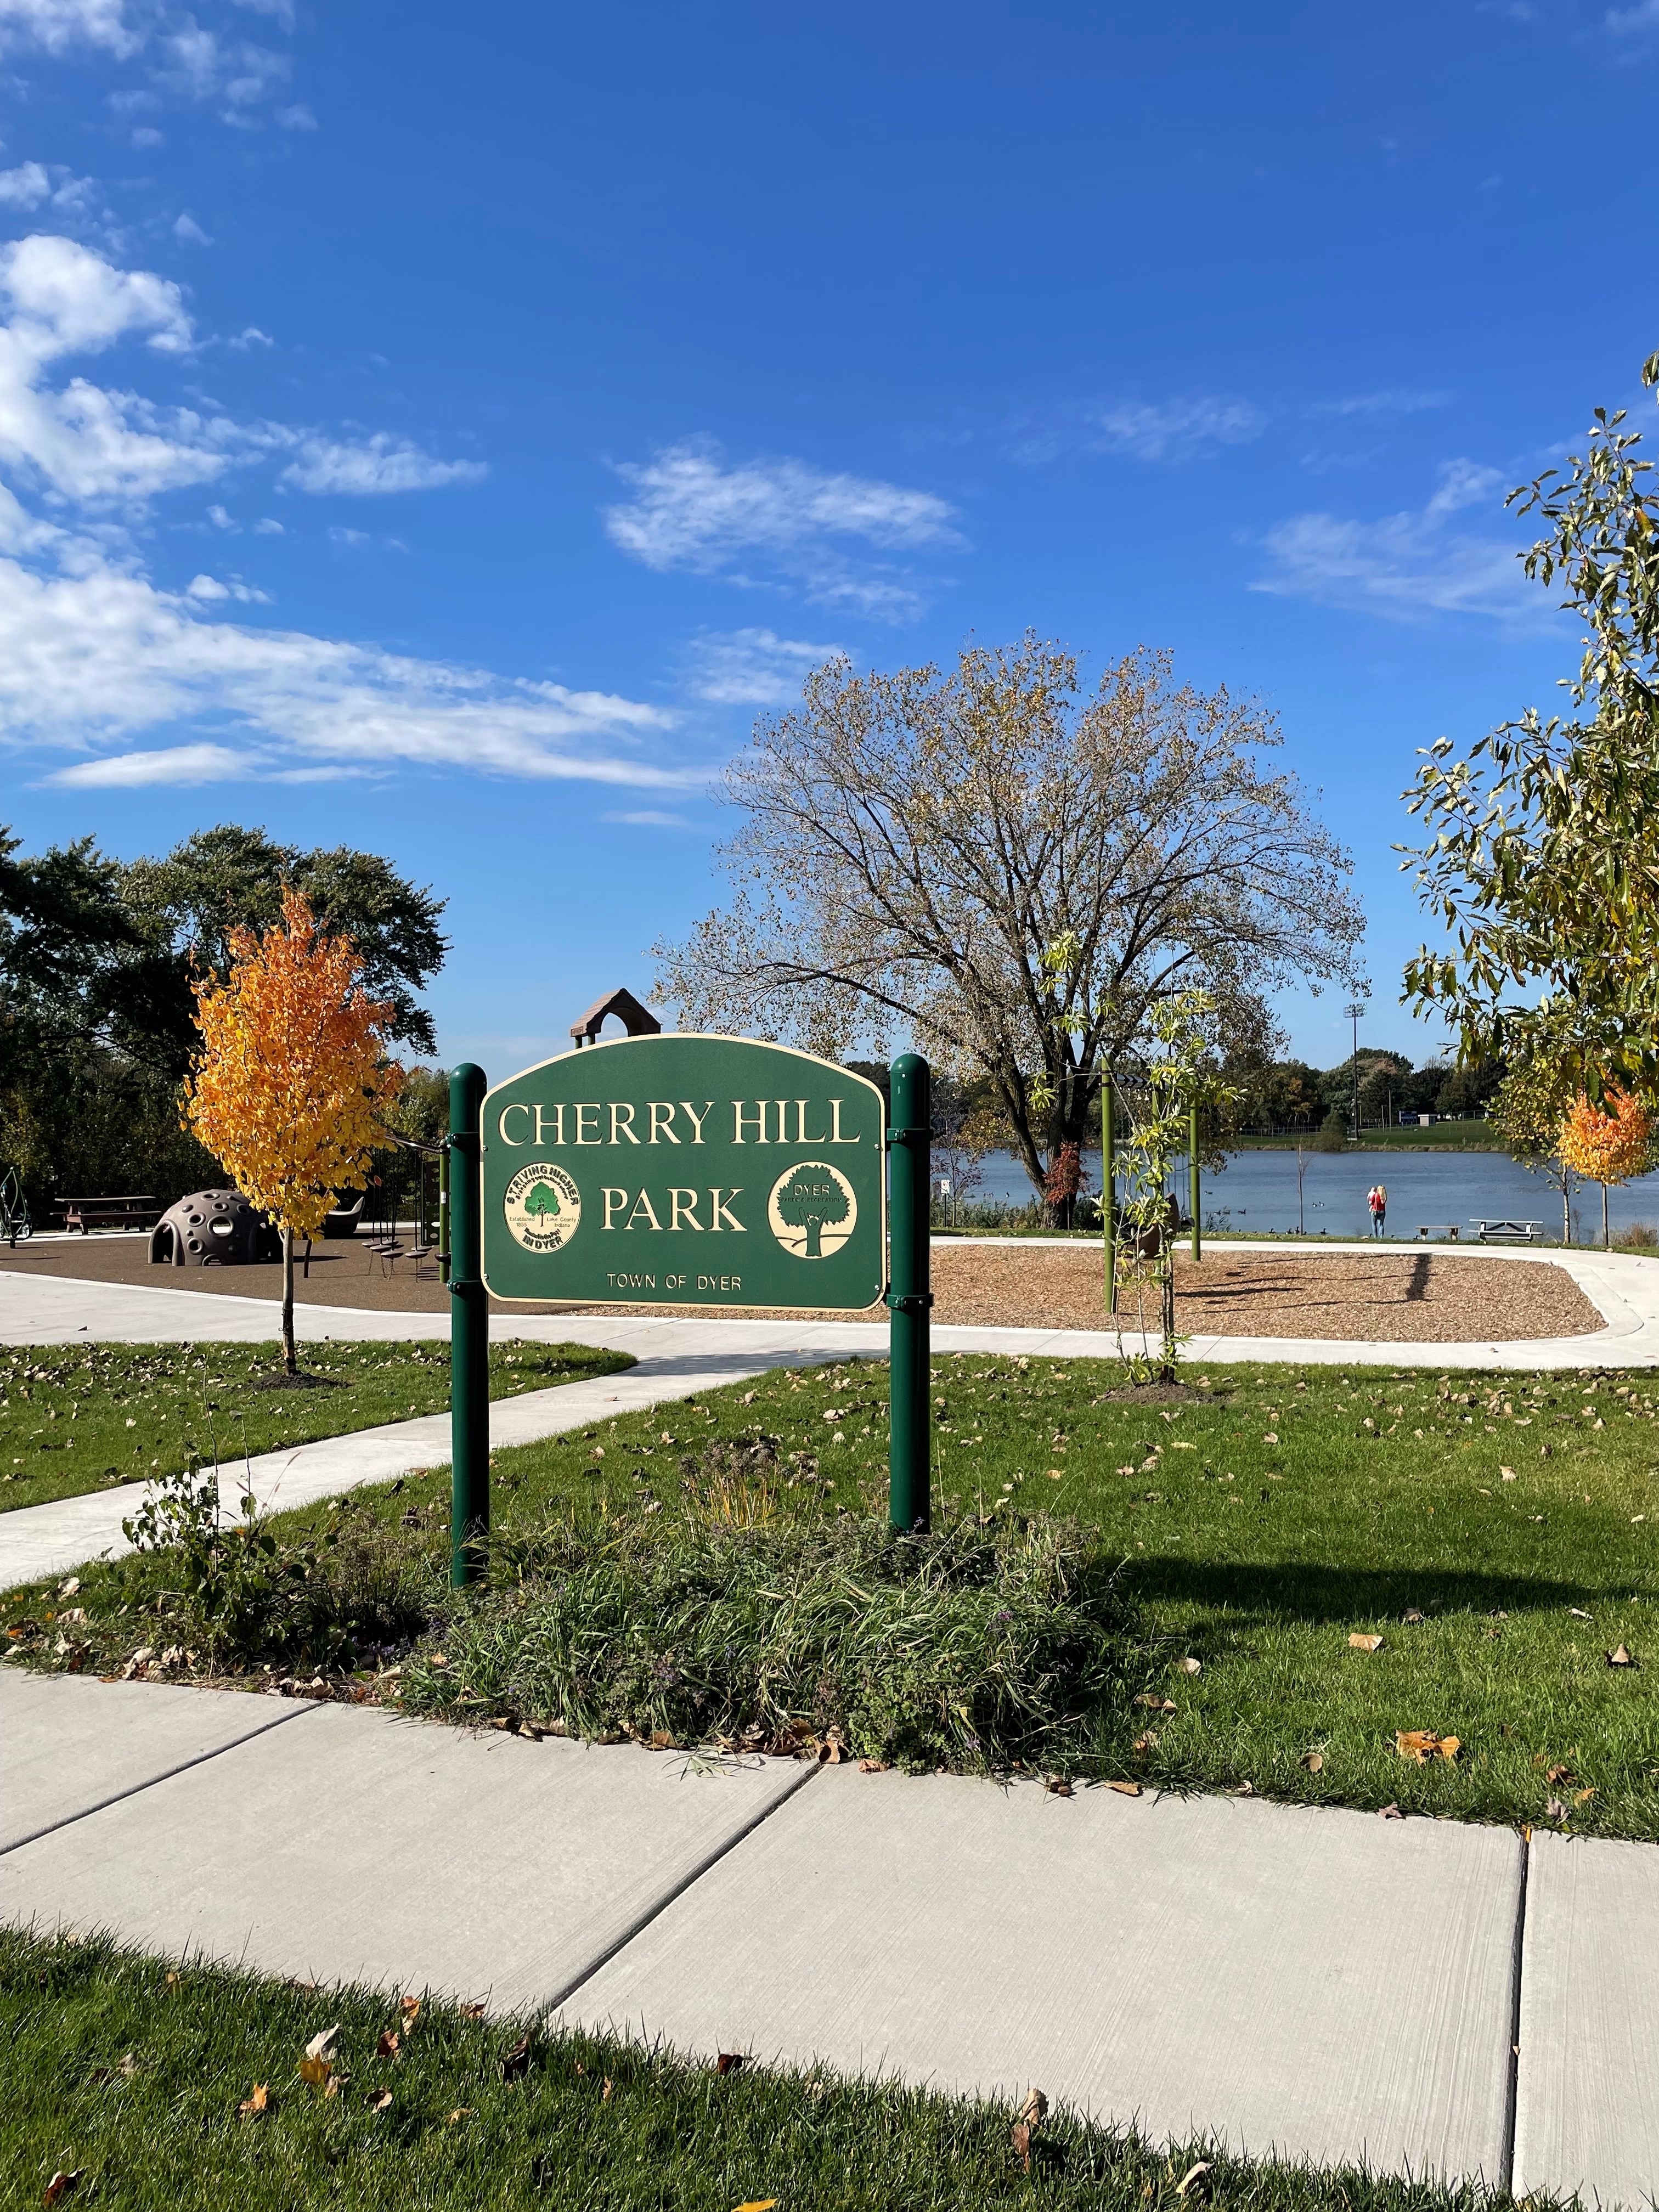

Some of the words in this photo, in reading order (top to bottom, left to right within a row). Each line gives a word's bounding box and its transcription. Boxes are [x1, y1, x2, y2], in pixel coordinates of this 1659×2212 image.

[498, 1101, 714, 1146] CHERRY
[730, 1099, 861, 1143] HILL
[506, 1165, 548, 1205] STRIVING
[549, 1167, 579, 1205] HIGHER
[793, 1183, 830, 1195] DYER
[600, 1187, 748, 1232] PARK
[522, 1234, 534, 1247] IN
[534, 1235, 563, 1249] DYER
[607, 1273, 656, 1289] TOWN
[665, 1274, 687, 1289] OF
[697, 1276, 742, 1291] DYER
